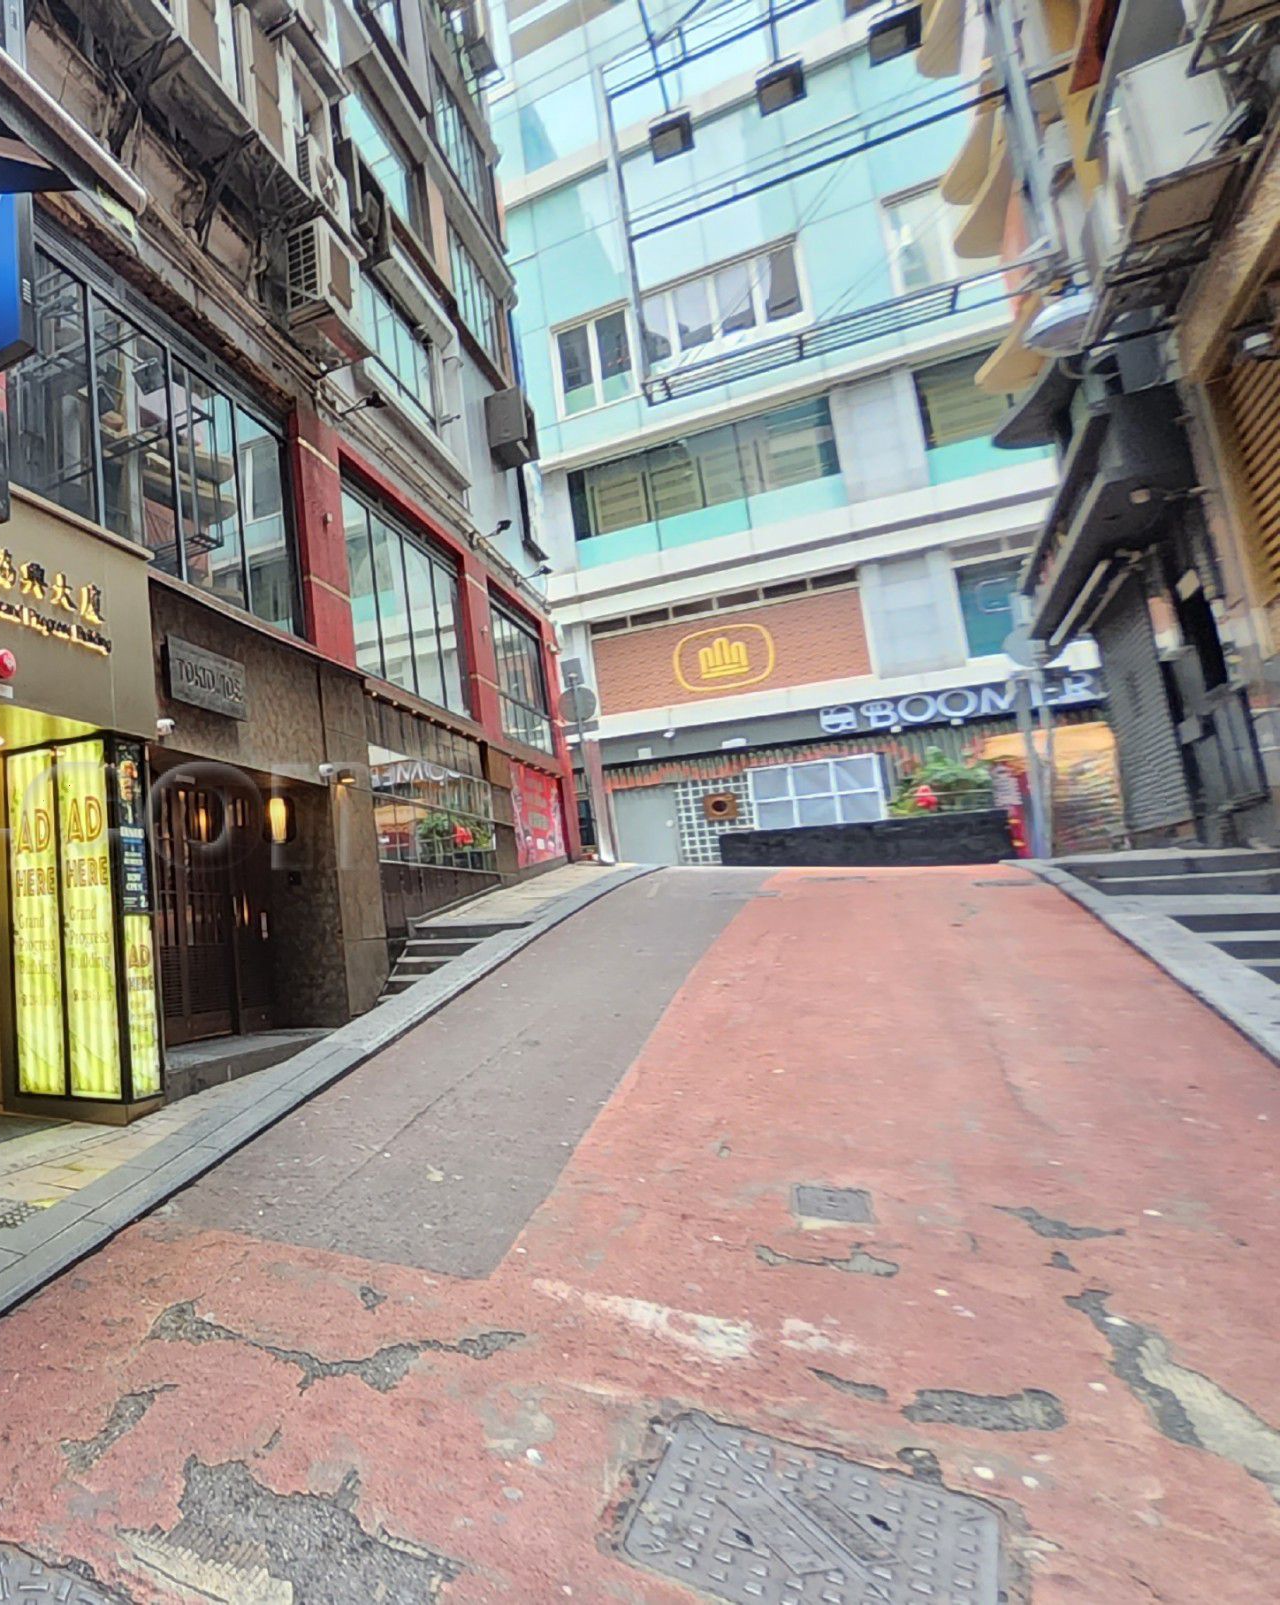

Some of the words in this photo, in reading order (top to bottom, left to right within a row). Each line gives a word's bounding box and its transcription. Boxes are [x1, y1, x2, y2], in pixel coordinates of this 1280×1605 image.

[17, 807, 52, 855] AD
[67, 795, 103, 845] AD
[15, 866, 56, 898] HERE
[65, 855, 109, 889] HERE
[128, 943, 151, 969] AD
